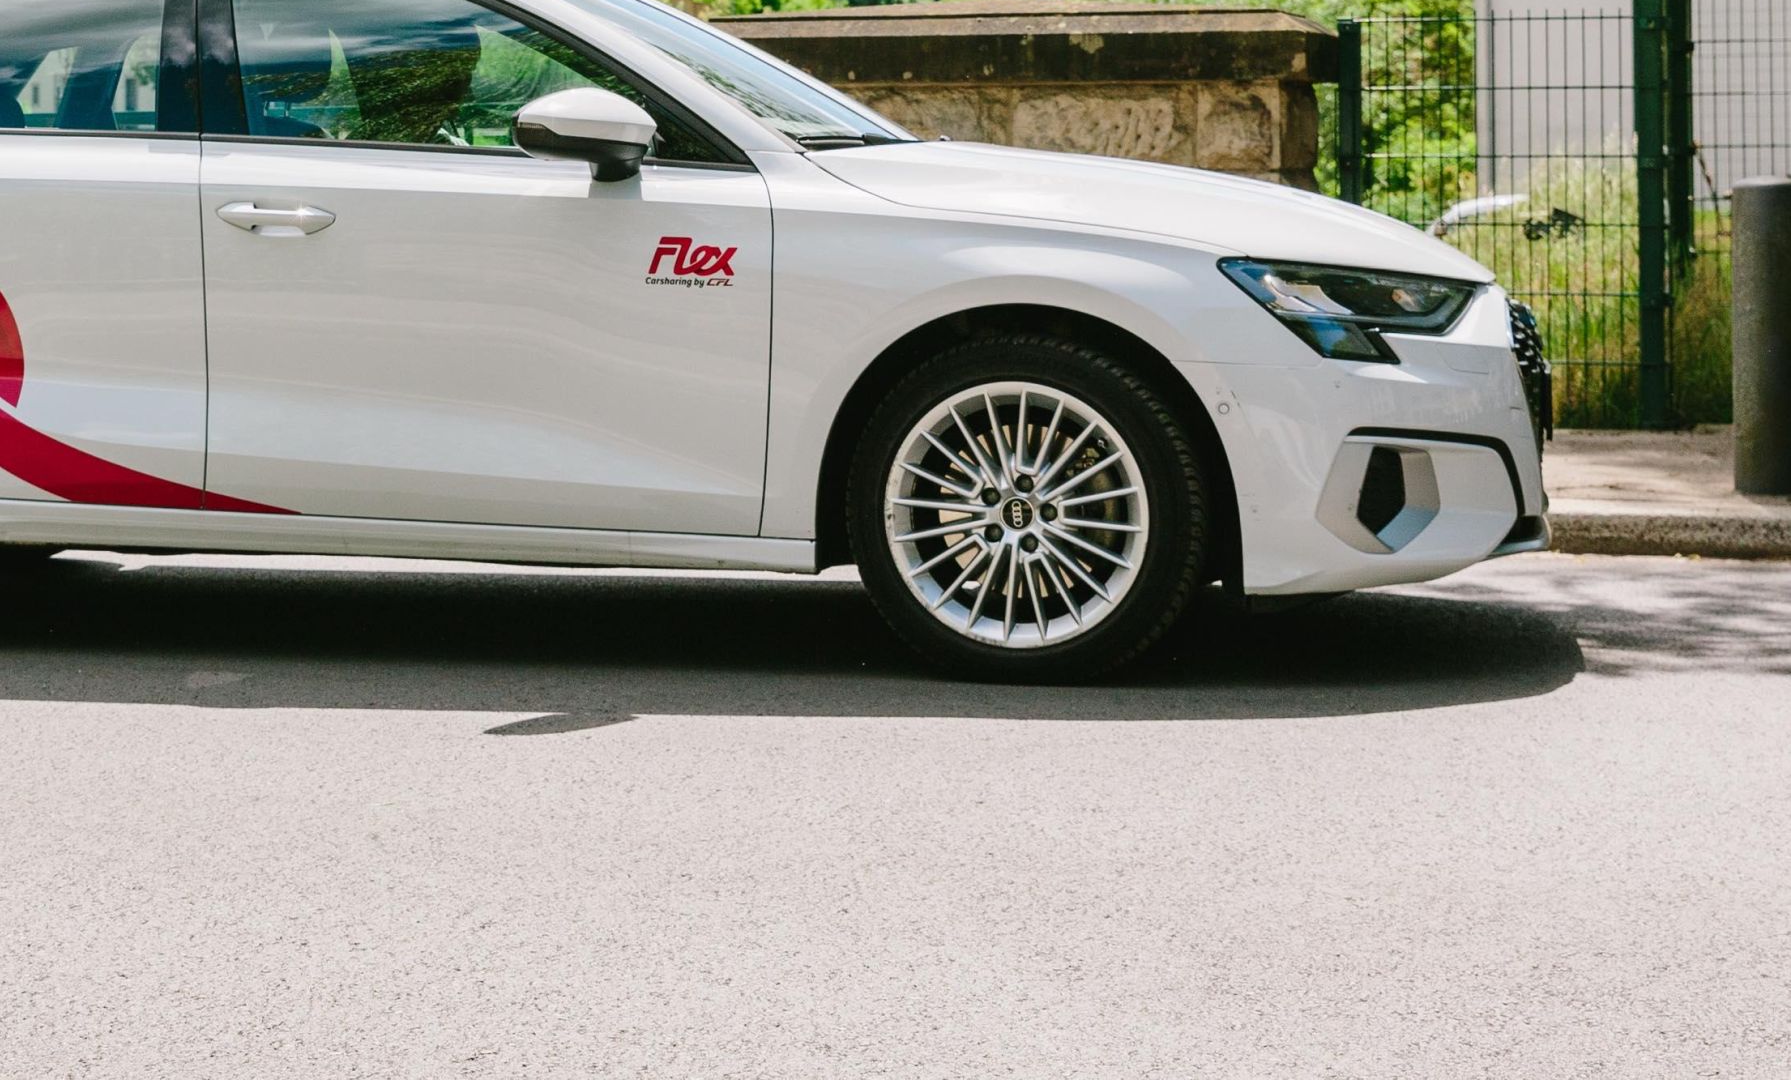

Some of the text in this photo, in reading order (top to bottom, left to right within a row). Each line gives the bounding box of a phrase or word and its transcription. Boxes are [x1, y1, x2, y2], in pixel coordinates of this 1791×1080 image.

[648, 236, 738, 276] Flex
[645, 277, 734, 288] Carsharing by CFL
